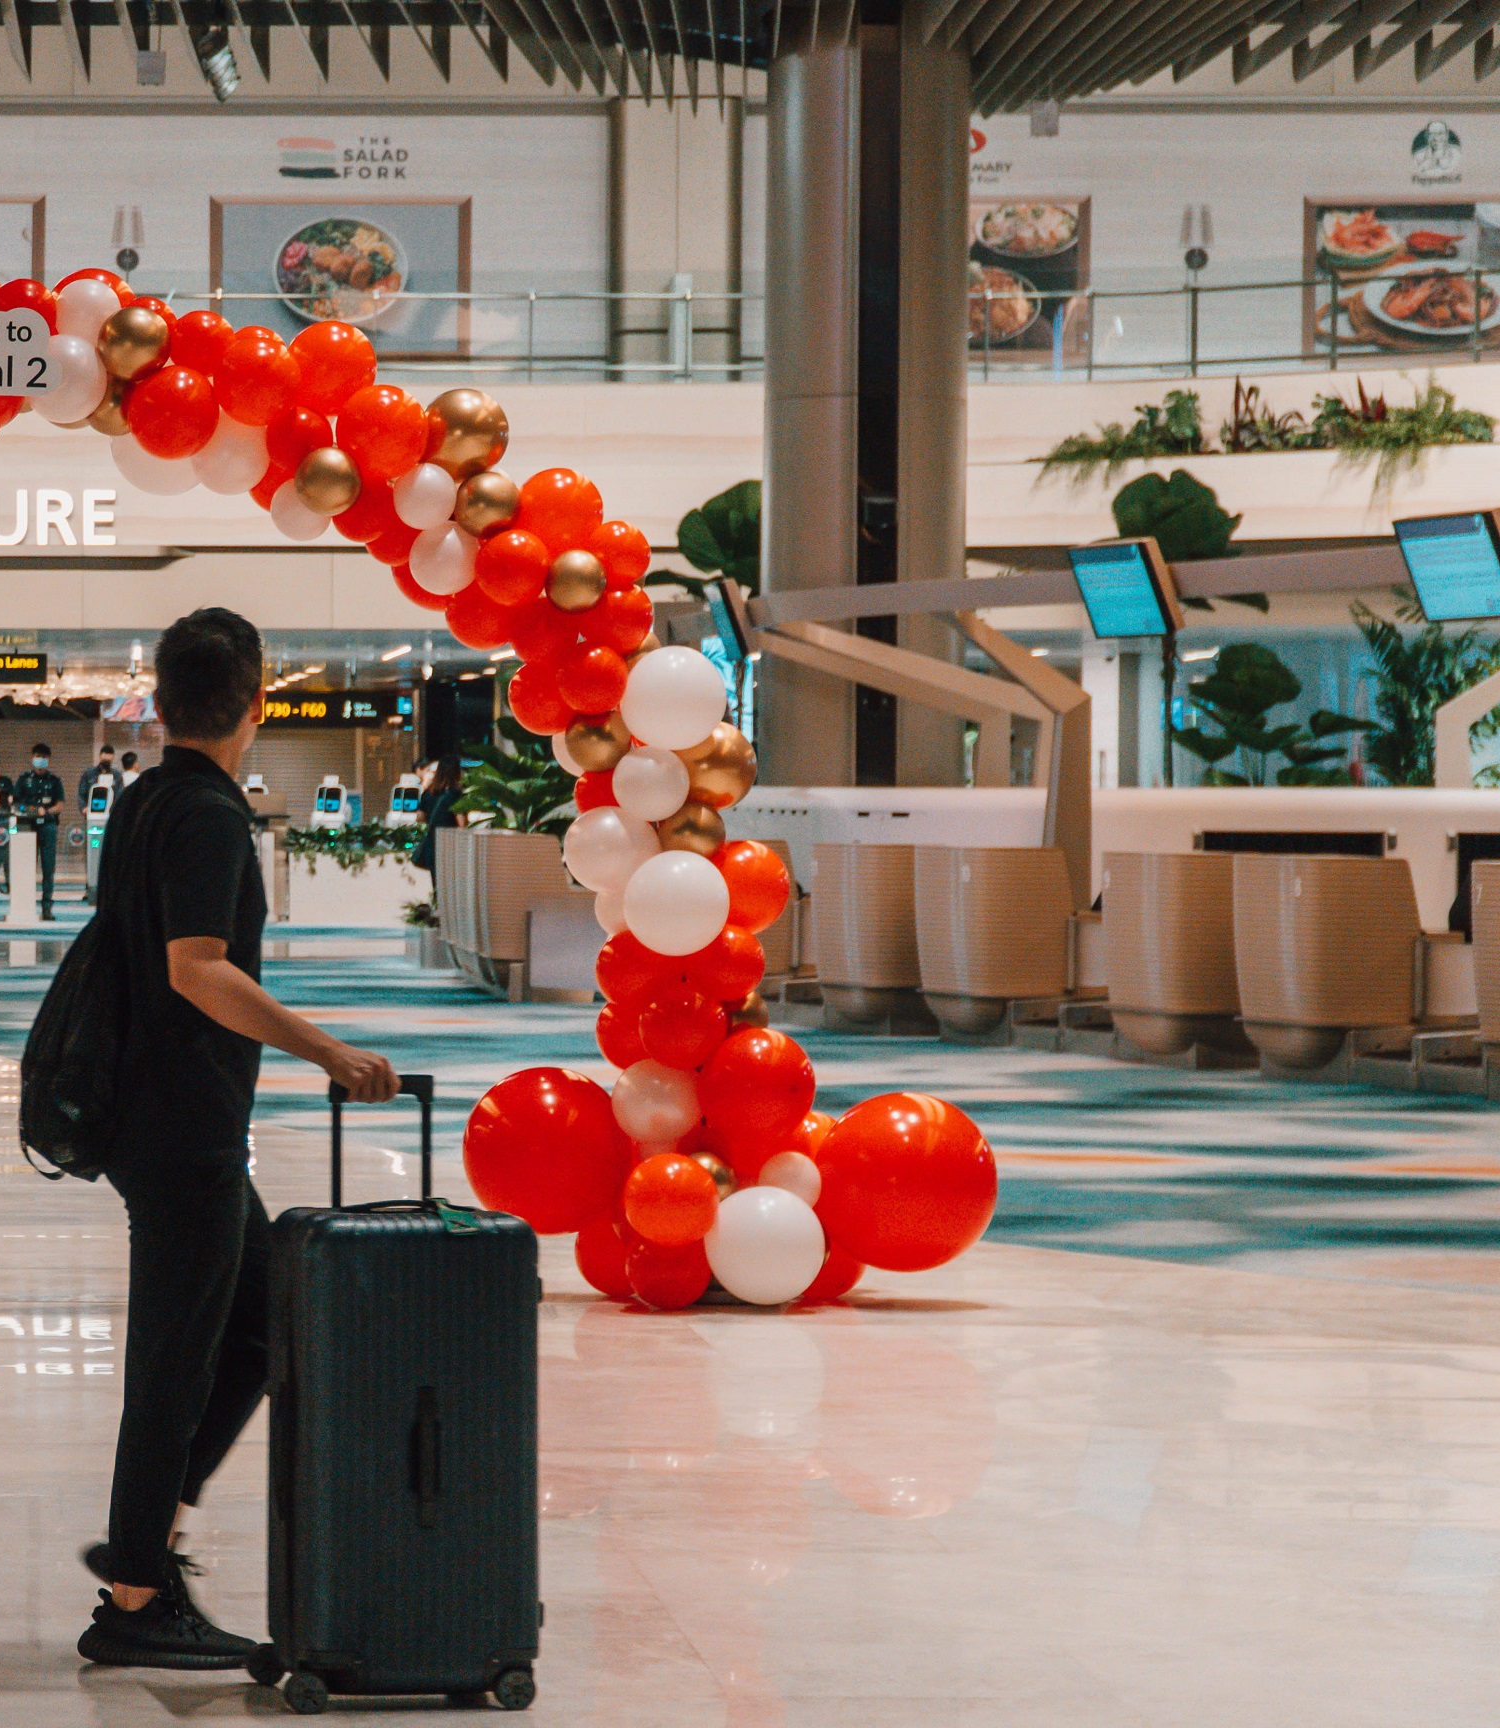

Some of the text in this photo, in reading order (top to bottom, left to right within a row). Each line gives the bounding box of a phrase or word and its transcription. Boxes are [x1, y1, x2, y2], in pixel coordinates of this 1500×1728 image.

[358, 136, 391, 146] THE
[343, 148, 409, 163] SALAD
[343, 165, 406, 179] FORK
[6, 320, 33, 343] to
[25, 356, 48, 389] 2
[5, 655, 39, 669] Lanes
